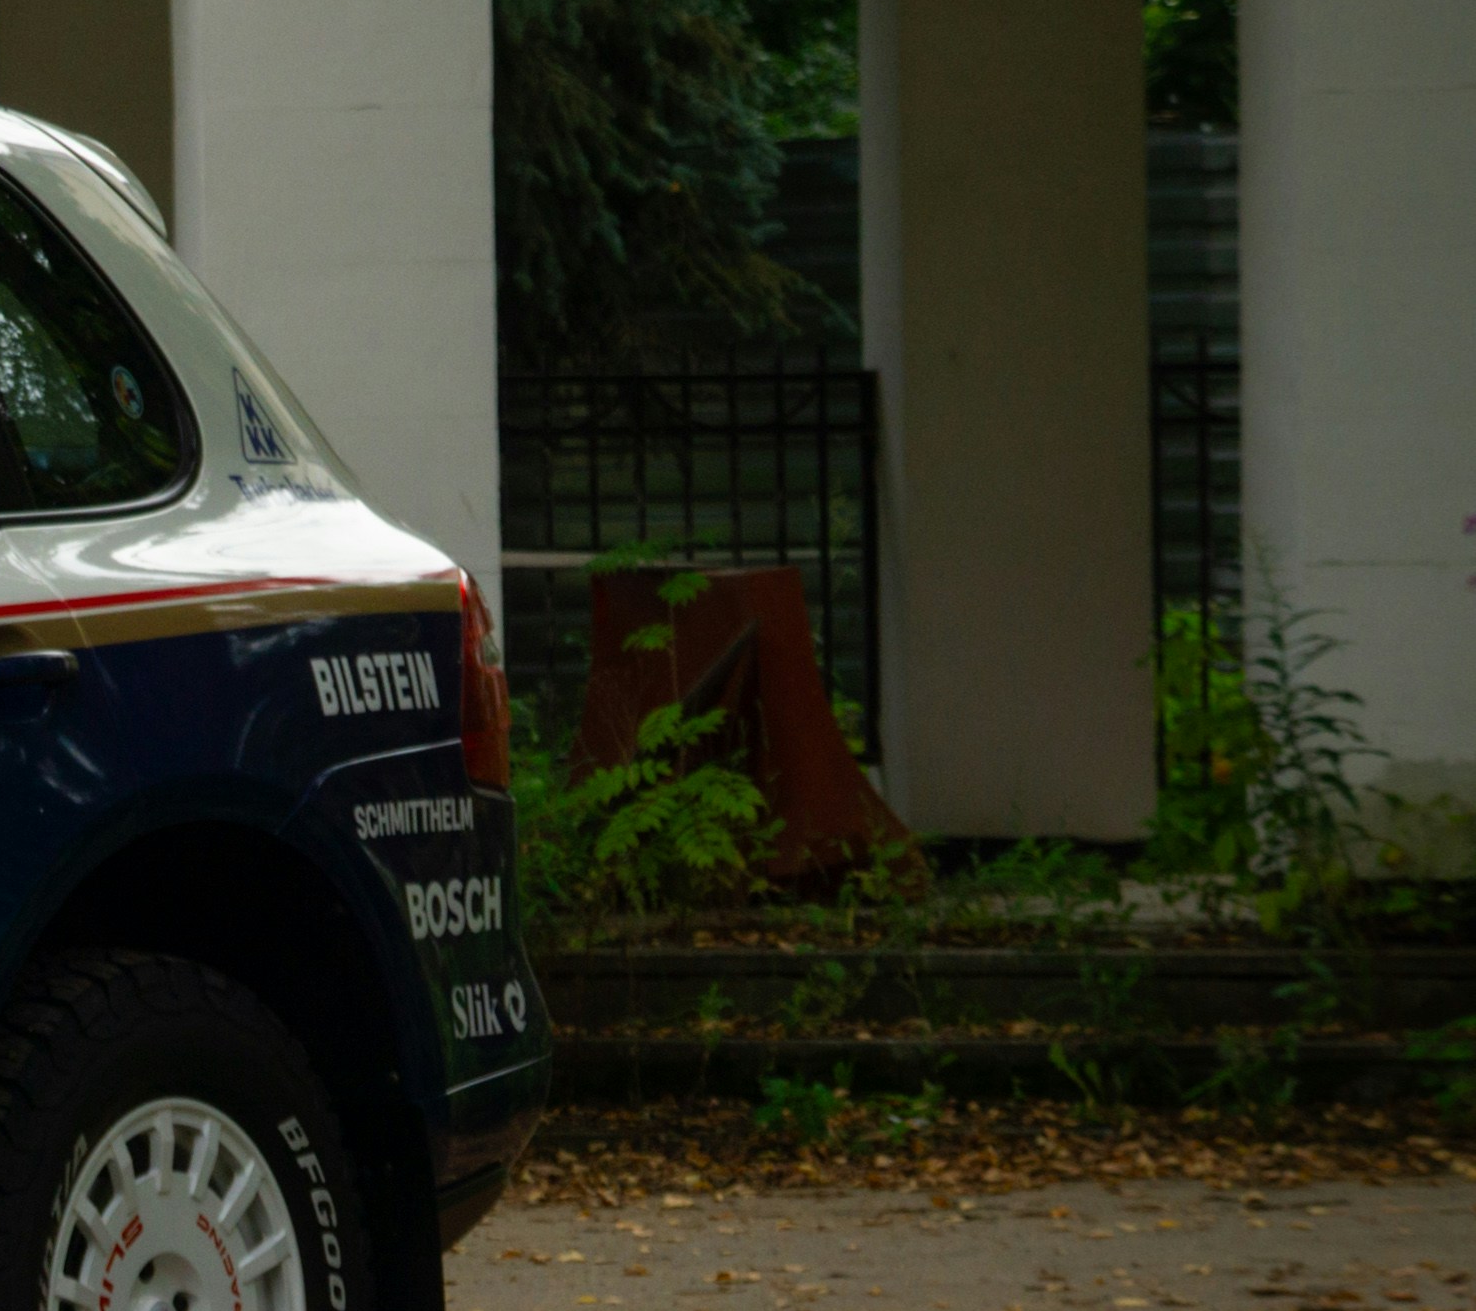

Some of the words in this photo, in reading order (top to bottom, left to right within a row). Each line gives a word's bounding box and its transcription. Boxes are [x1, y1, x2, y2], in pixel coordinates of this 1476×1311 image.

[310, 651, 440, 717] BILSTEIN
[353, 796, 474, 841] SCHMITTHELM
[405, 875, 502, 940] BOSCH
[451, 982, 504, 1040] Slik
